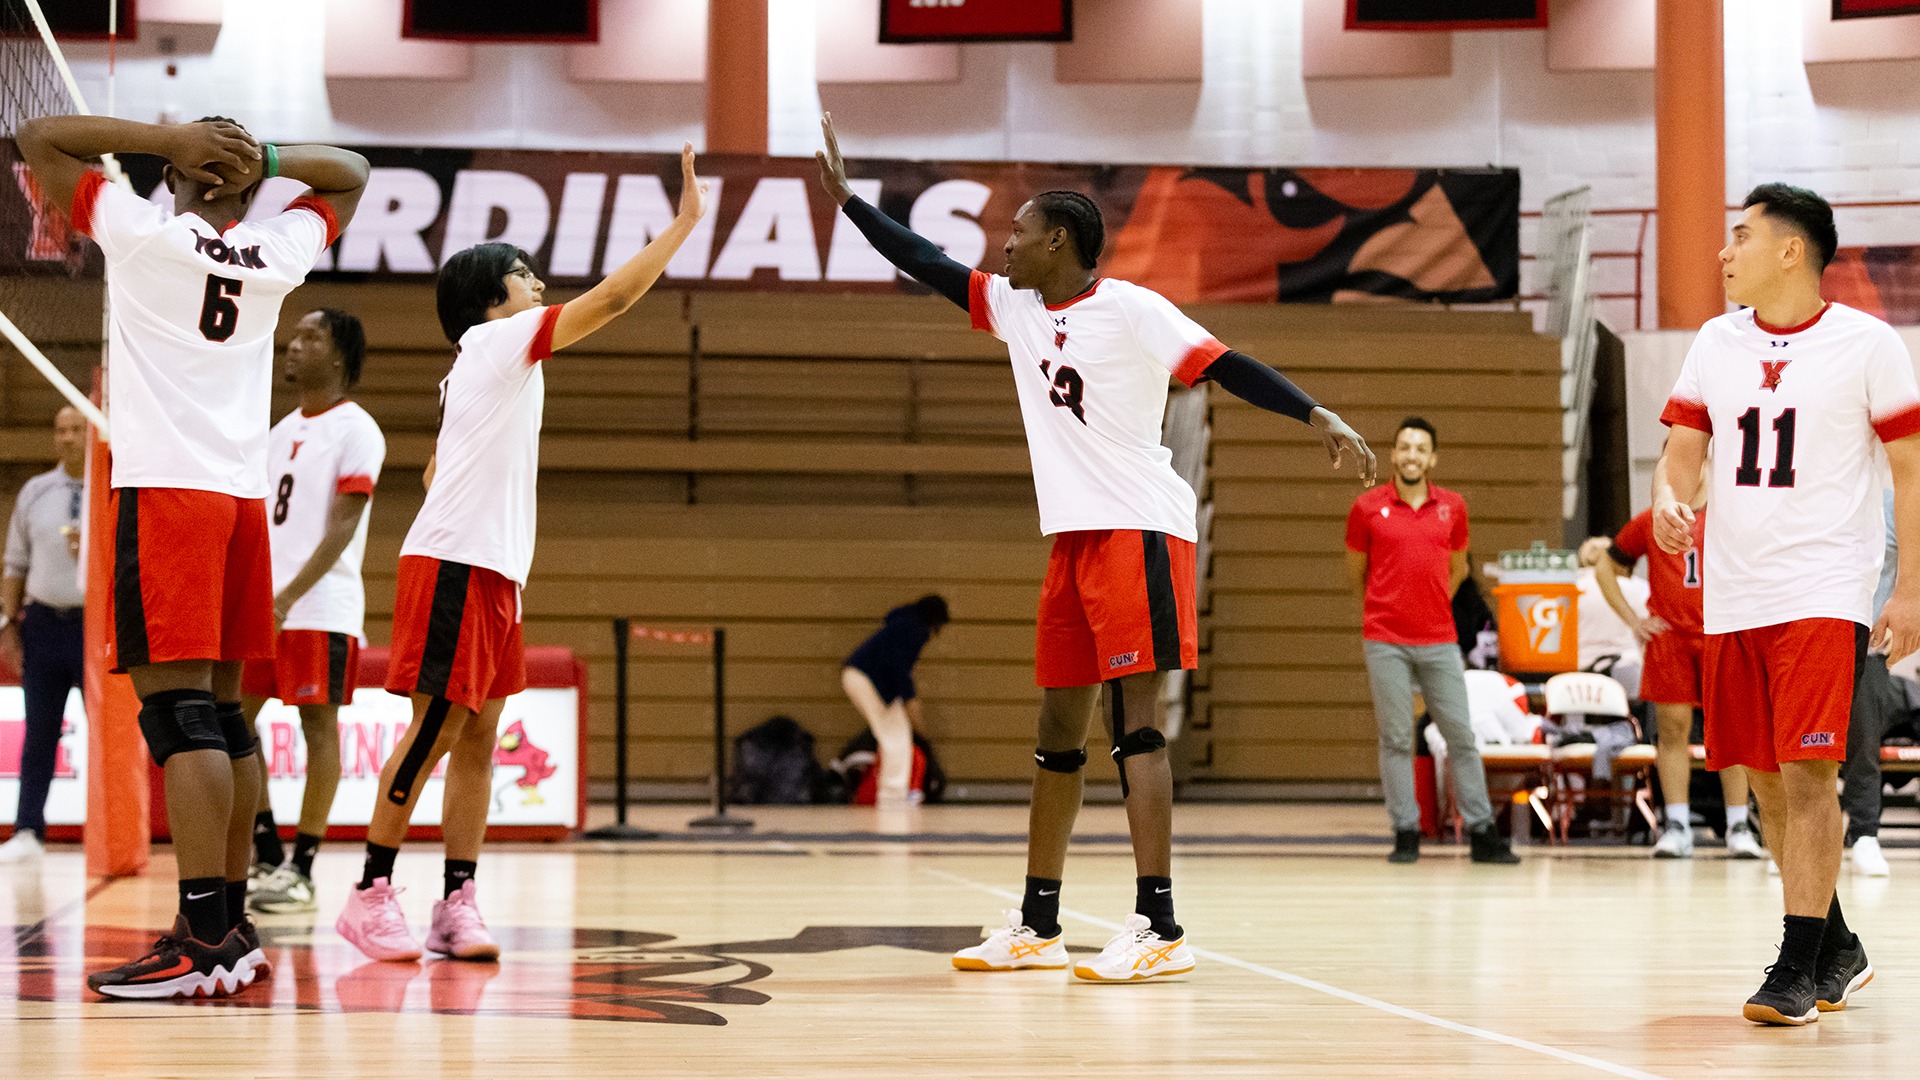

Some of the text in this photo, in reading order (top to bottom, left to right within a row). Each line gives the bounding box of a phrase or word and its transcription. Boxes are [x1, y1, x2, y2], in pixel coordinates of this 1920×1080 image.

[189, 228, 268, 270] YORK
[198, 273, 243, 343] 6
[1735, 406, 1796, 488] 11
[273, 473, 294, 526] 8
[1683, 546, 1701, 588] 1
[1532, 599, 1558, 628] G
